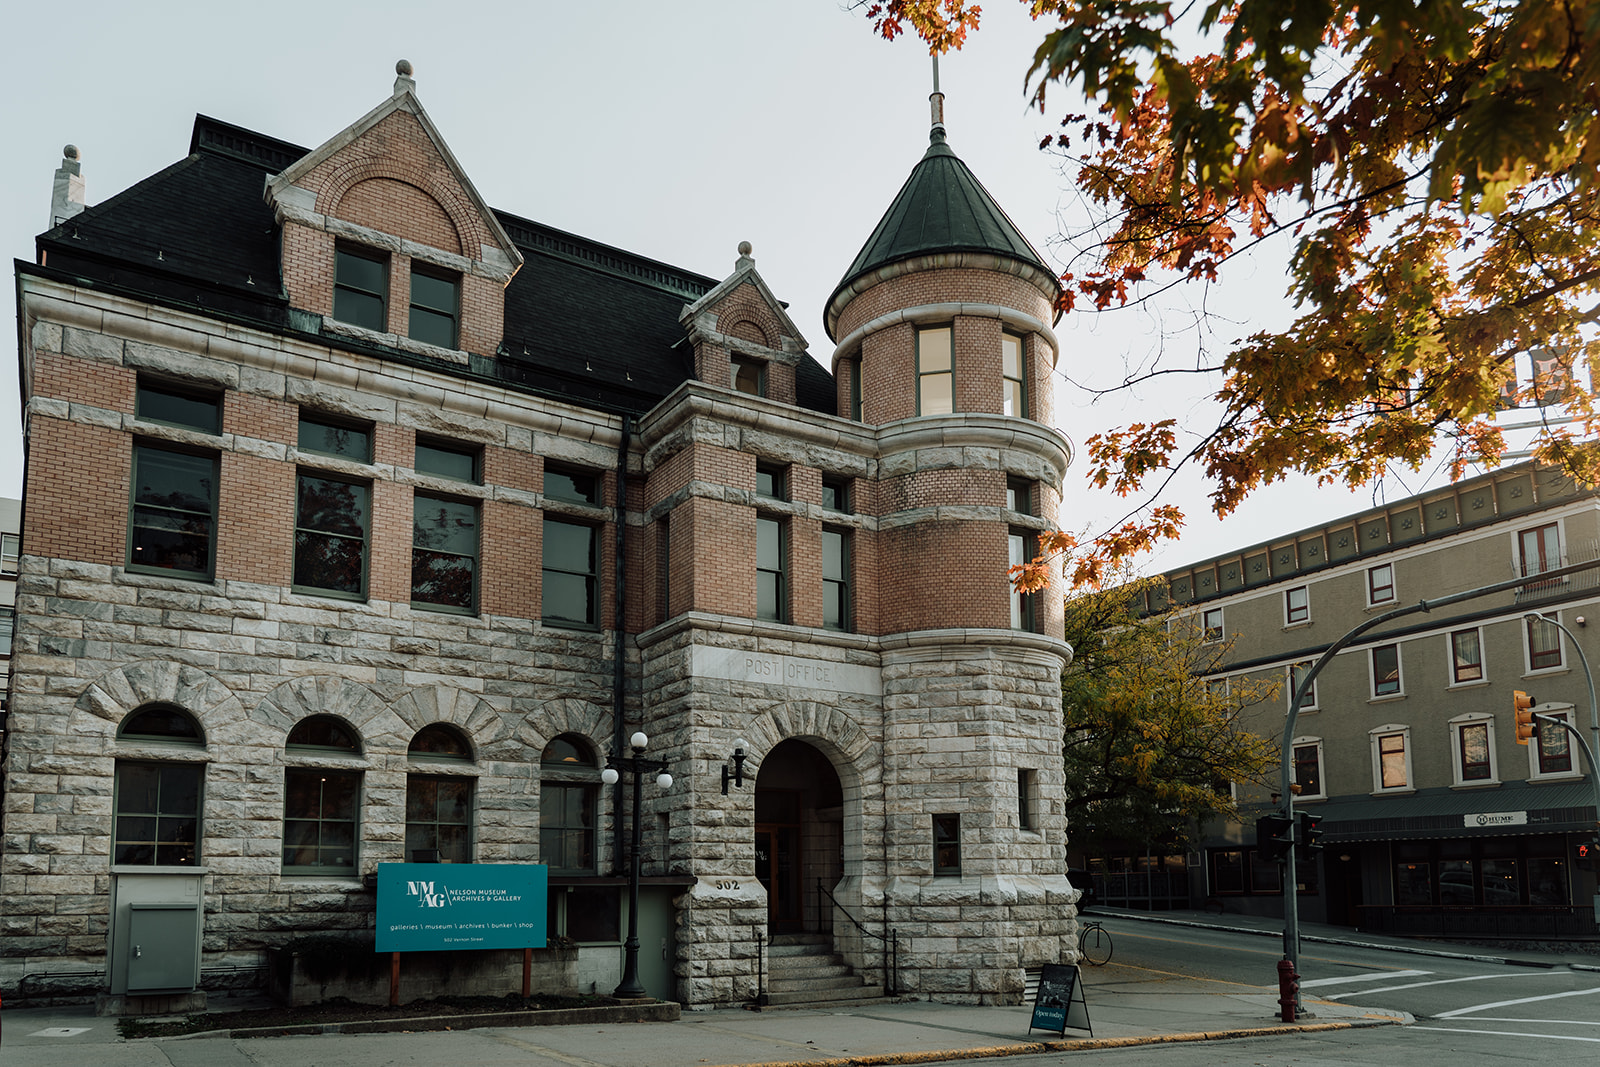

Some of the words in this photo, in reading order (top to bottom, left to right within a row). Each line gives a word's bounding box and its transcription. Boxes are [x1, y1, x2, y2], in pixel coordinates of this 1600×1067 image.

[745, 658, 779, 677] POST
[716, 880, 740, 890] 502
[390, 923, 418, 932] galleries
[458, 922, 485, 930] archives
[518, 922, 534, 930] shop
[1035, 1009, 1049, 1018] Open
